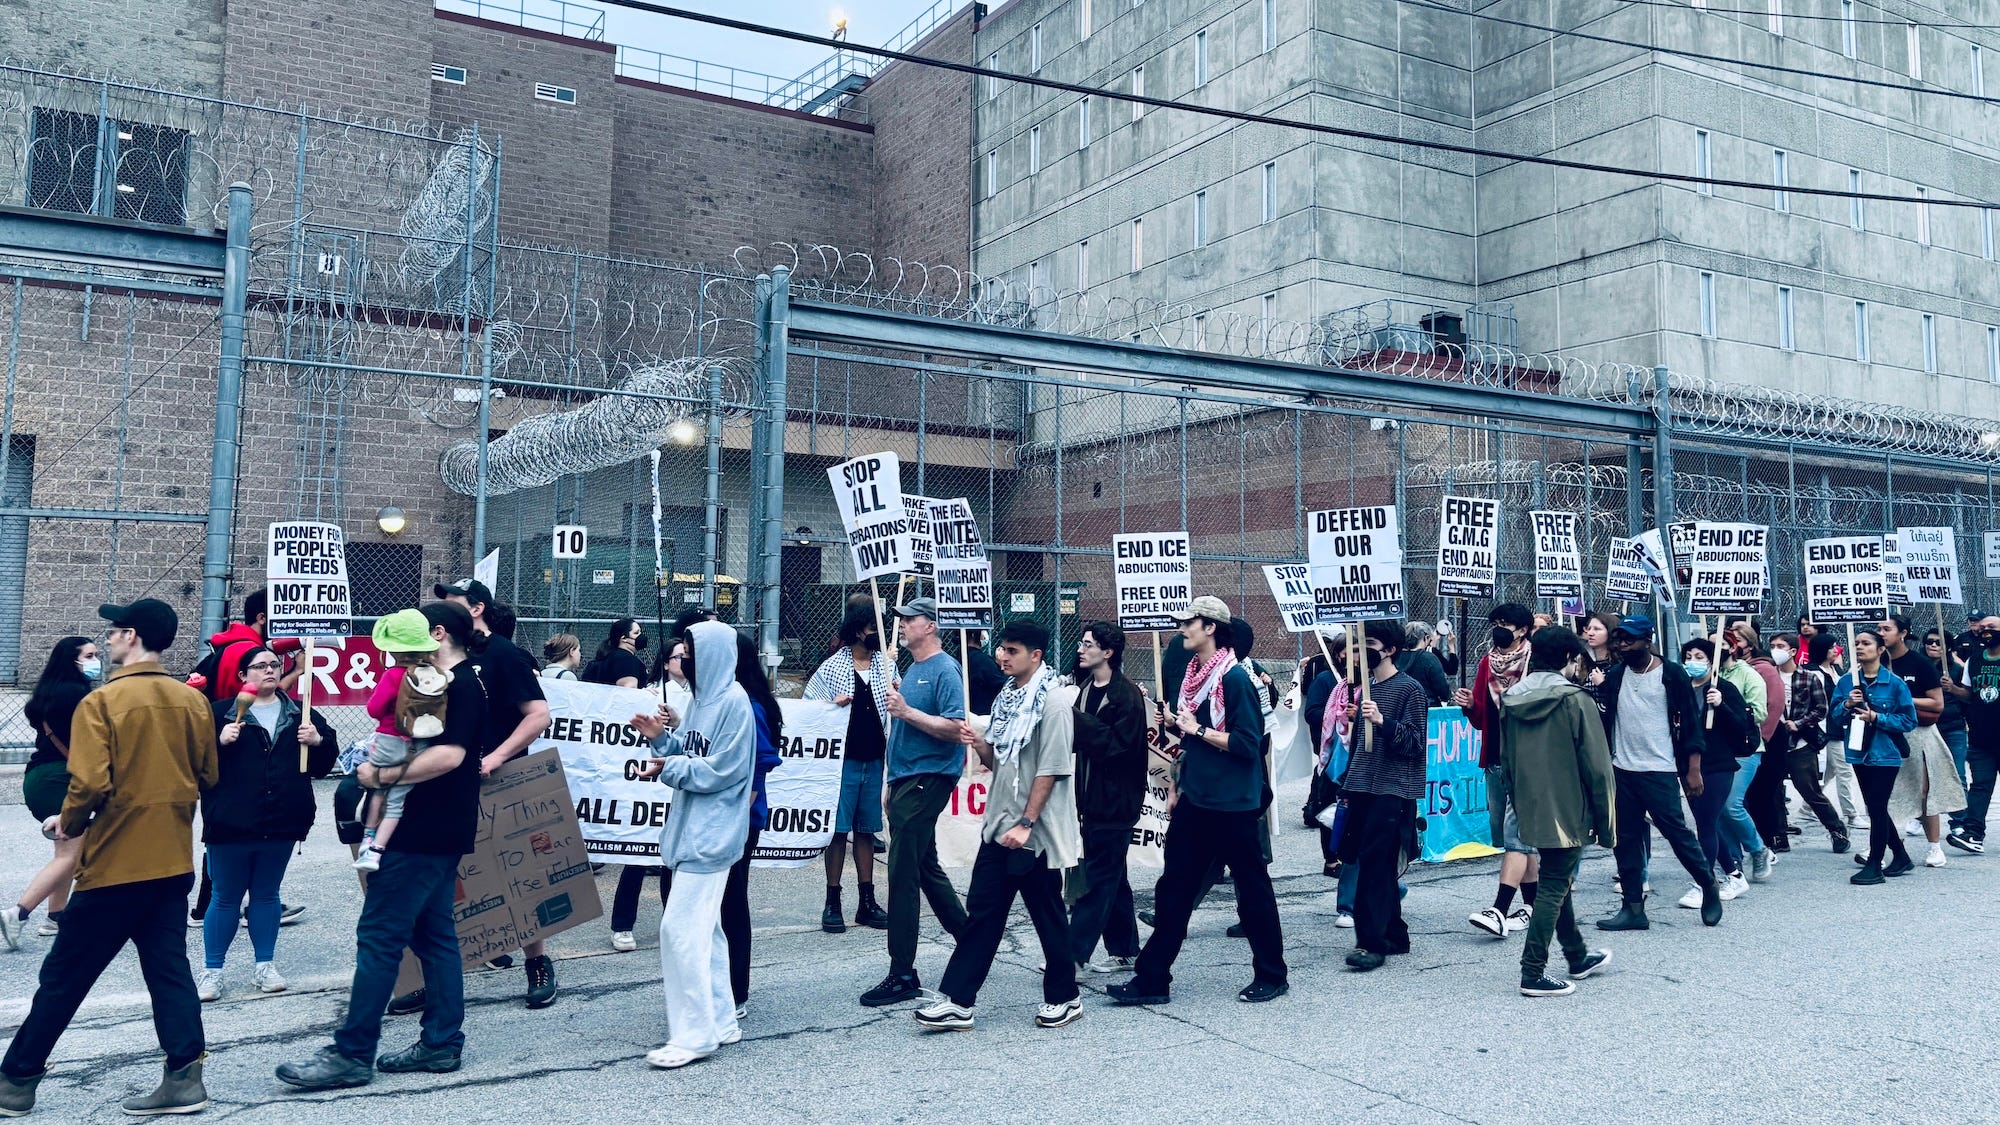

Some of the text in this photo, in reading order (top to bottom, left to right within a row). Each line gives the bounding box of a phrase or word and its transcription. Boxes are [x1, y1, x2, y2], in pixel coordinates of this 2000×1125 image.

[843, 458, 881, 488] STOP
[853, 485, 886, 517] ALL
[929, 505, 949, 520] THE
[1316, 508, 1386, 533] DEFEND
[1446, 498, 1494, 528] FREE
[274, 526, 340, 541] MONEY FOR
[1534, 513, 1572, 536] FREE
[557, 530, 584, 554] 10
[1448, 525, 1489, 547] G.M.G
[1541, 536, 1572, 553] G.M.G
[1698, 529, 1764, 547] END ICE
[274, 540, 343, 559] PEOPLE'S
[1118, 539, 1187, 558] END ICE
[1335, 534, 1372, 557] OUR
[1809, 542, 1881, 560] END ICE
[913, 552, 933, 562] IRES!
[1442, 548, 1493, 568] END ALL
[1538, 556, 1578, 571] END ALL
[1626, 561, 1643, 570] DEFE
[1695, 551, 1763, 562] ABDUCTIONS:
[287, 557, 339, 575] NEEDS
[1118, 562, 1188, 574] ABDUCTIONS:
[1274, 566, 1307, 580] STOP
[1340, 564, 1371, 585] LAO
[1810, 562, 1882, 575] ABDUCTIONS:
[1906, 566, 1951, 580] KEEP LAY
[937, 567, 988, 584] IMMIGRANT
[1610, 570, 1649, 582] IMMIGRANT
[1697, 571, 1731, 585] FREE
[1734, 571, 1760, 585] OUR
[274, 584, 347, 602] NOT FOR
[939, 585, 990, 603] FAMILIES!
[1121, 585, 1188, 600] FREE OUR
[1285, 580, 1313, 597] ALL
[1314, 583, 1402, 604] COMMUNITY!
[1695, 587, 1759, 597] PEOPLE NOW!
[1813, 582, 1882, 596] FREE OUR
[1919, 586, 1952, 600] HOME!
[273, 604, 348, 615] DEPORATIONS!
[1121, 602, 1159, 613] PEOPLE
[1813, 597, 1852, 607] PEOPLE
[1855, 596, 1883, 606] NOW!
[778, 736, 842, 759] RA-DE
[1426, 719, 1482, 763] HUMA
[1426, 776, 1489, 816] IS IL
[503, 799, 561, 827] Thing
[576, 797, 672, 827] ALL DE
[765, 807, 831, 833] IONS!
[625, 844, 645, 853] AND
